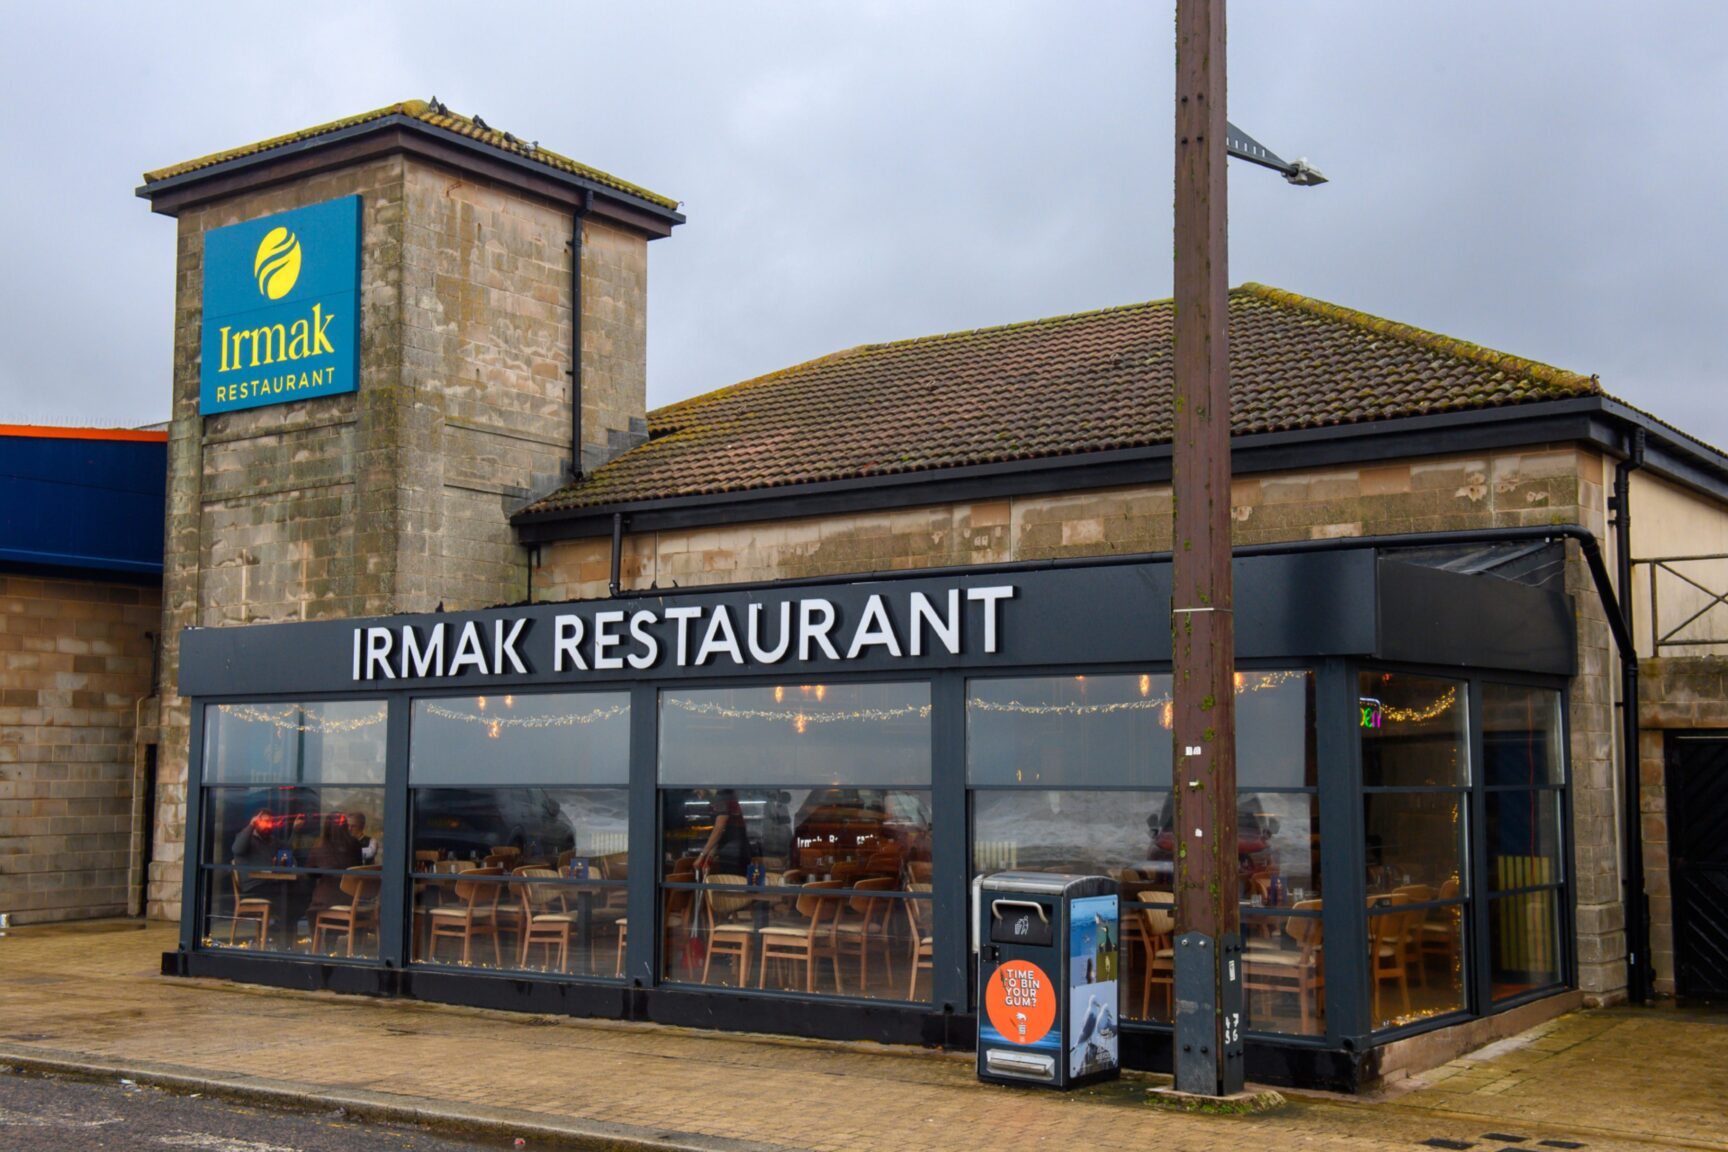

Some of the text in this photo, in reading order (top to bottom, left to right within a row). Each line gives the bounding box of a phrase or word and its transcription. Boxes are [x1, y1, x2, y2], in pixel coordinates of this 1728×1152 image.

[218, 302, 335, 373] Irmak
[216, 367, 335, 403] RESTAURANT
[352, 585, 1014, 681] IRMAK RESTAURANT
[1007, 969, 1034, 980] TIME
[1003, 977, 1040, 989] TO BIN
[1006, 987, 1037, 998] YOUR
[1005, 996, 1037, 1008] GUM?
